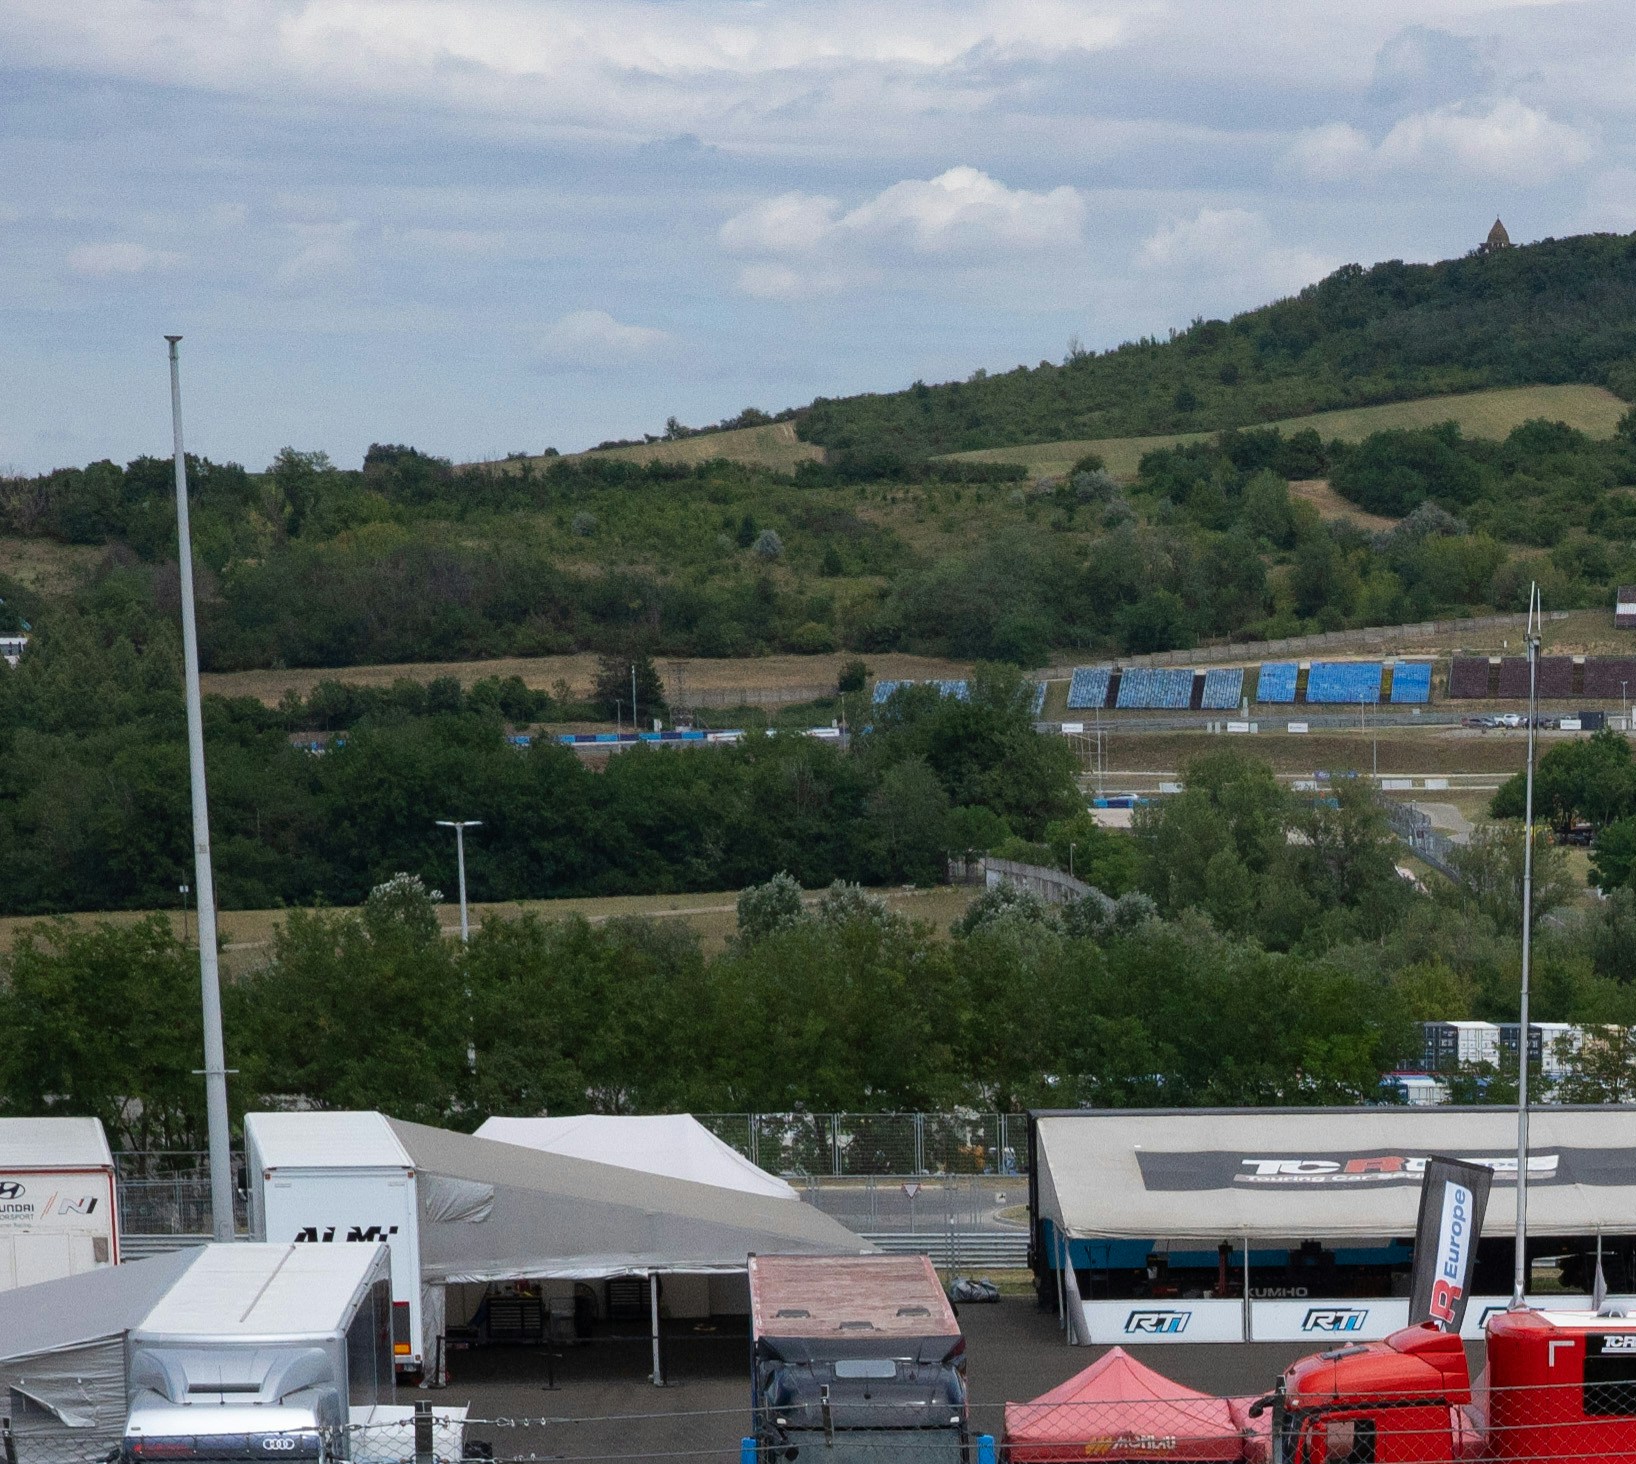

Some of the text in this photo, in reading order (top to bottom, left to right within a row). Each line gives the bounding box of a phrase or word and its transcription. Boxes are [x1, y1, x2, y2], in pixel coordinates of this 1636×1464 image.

[1241, 1156, 1406, 1175] TCR
[1443, 1188, 1467, 1280] Europe
[1249, 1287, 1309, 1298] KUMHO
[1125, 1309, 1193, 1334] RTI
[1302, 1307, 1369, 1332] RTI
